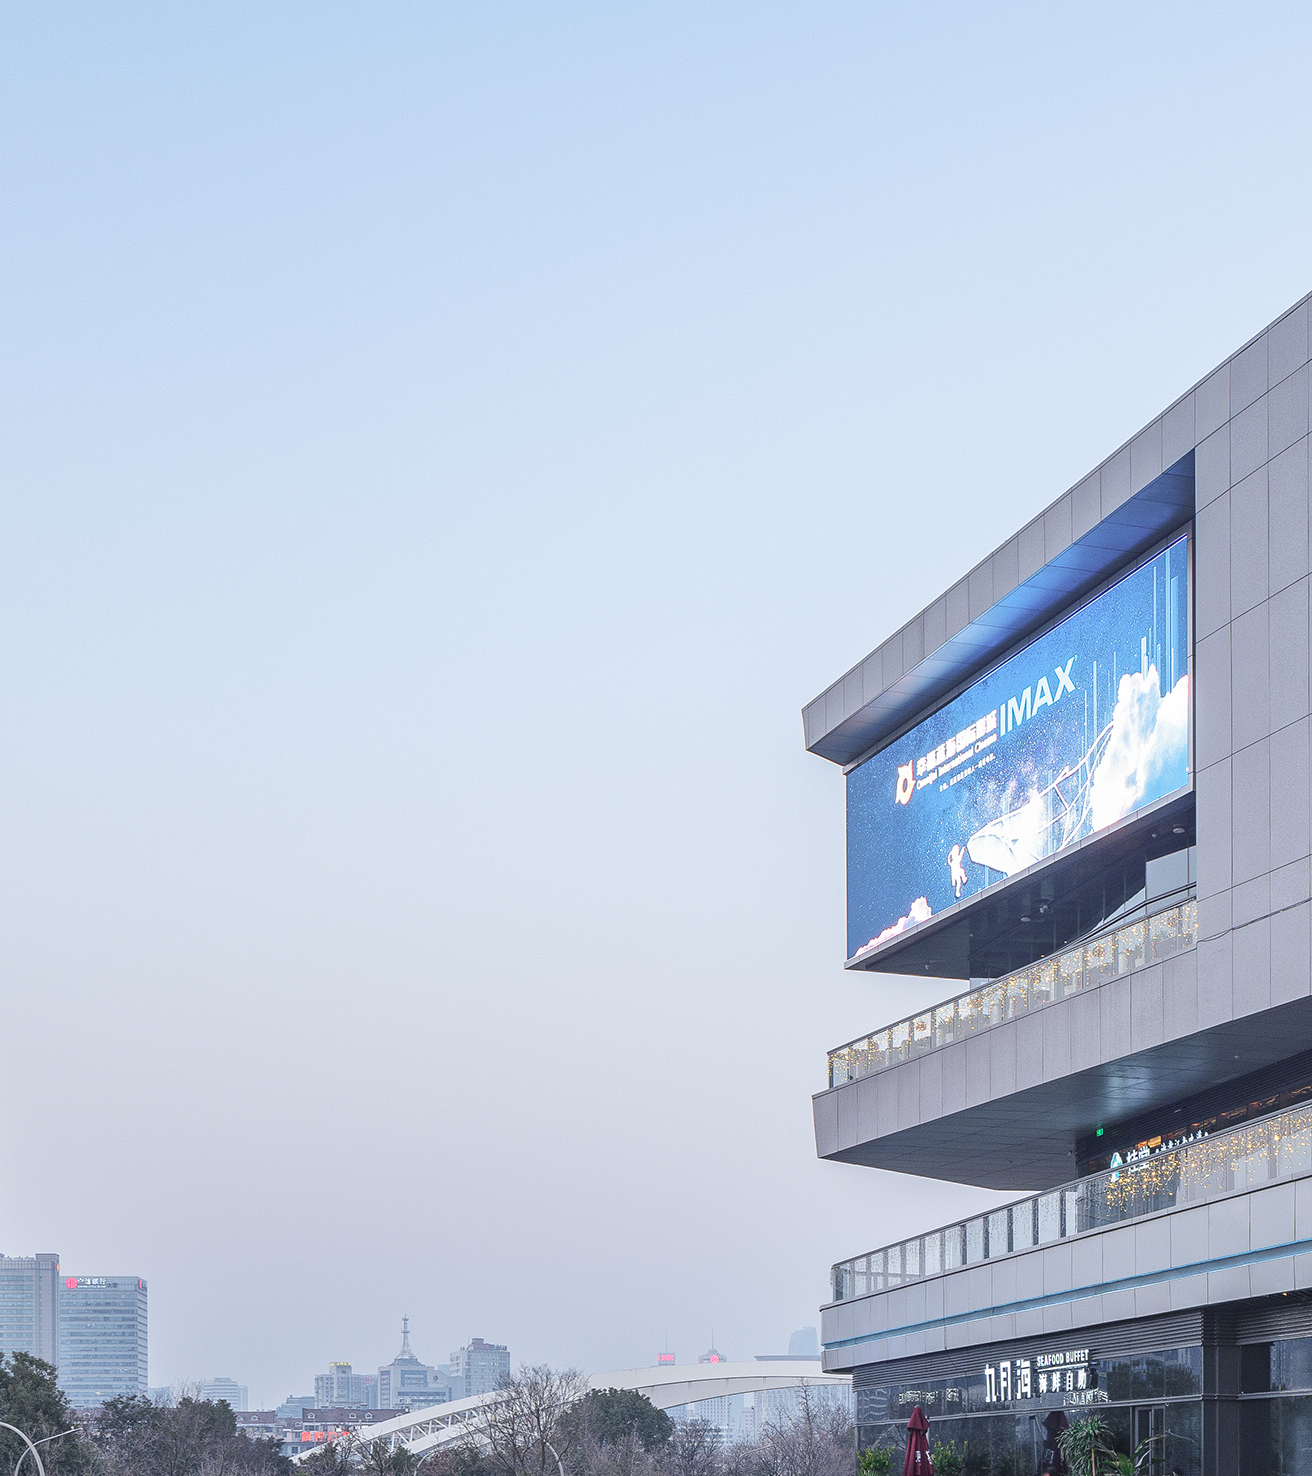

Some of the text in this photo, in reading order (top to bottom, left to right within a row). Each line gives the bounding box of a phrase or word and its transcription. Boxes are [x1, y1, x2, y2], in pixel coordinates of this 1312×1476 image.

[1000, 656, 1076, 737] IMAX
[1036, 1349, 1089, 1367] SEAFOOD BUFFET
